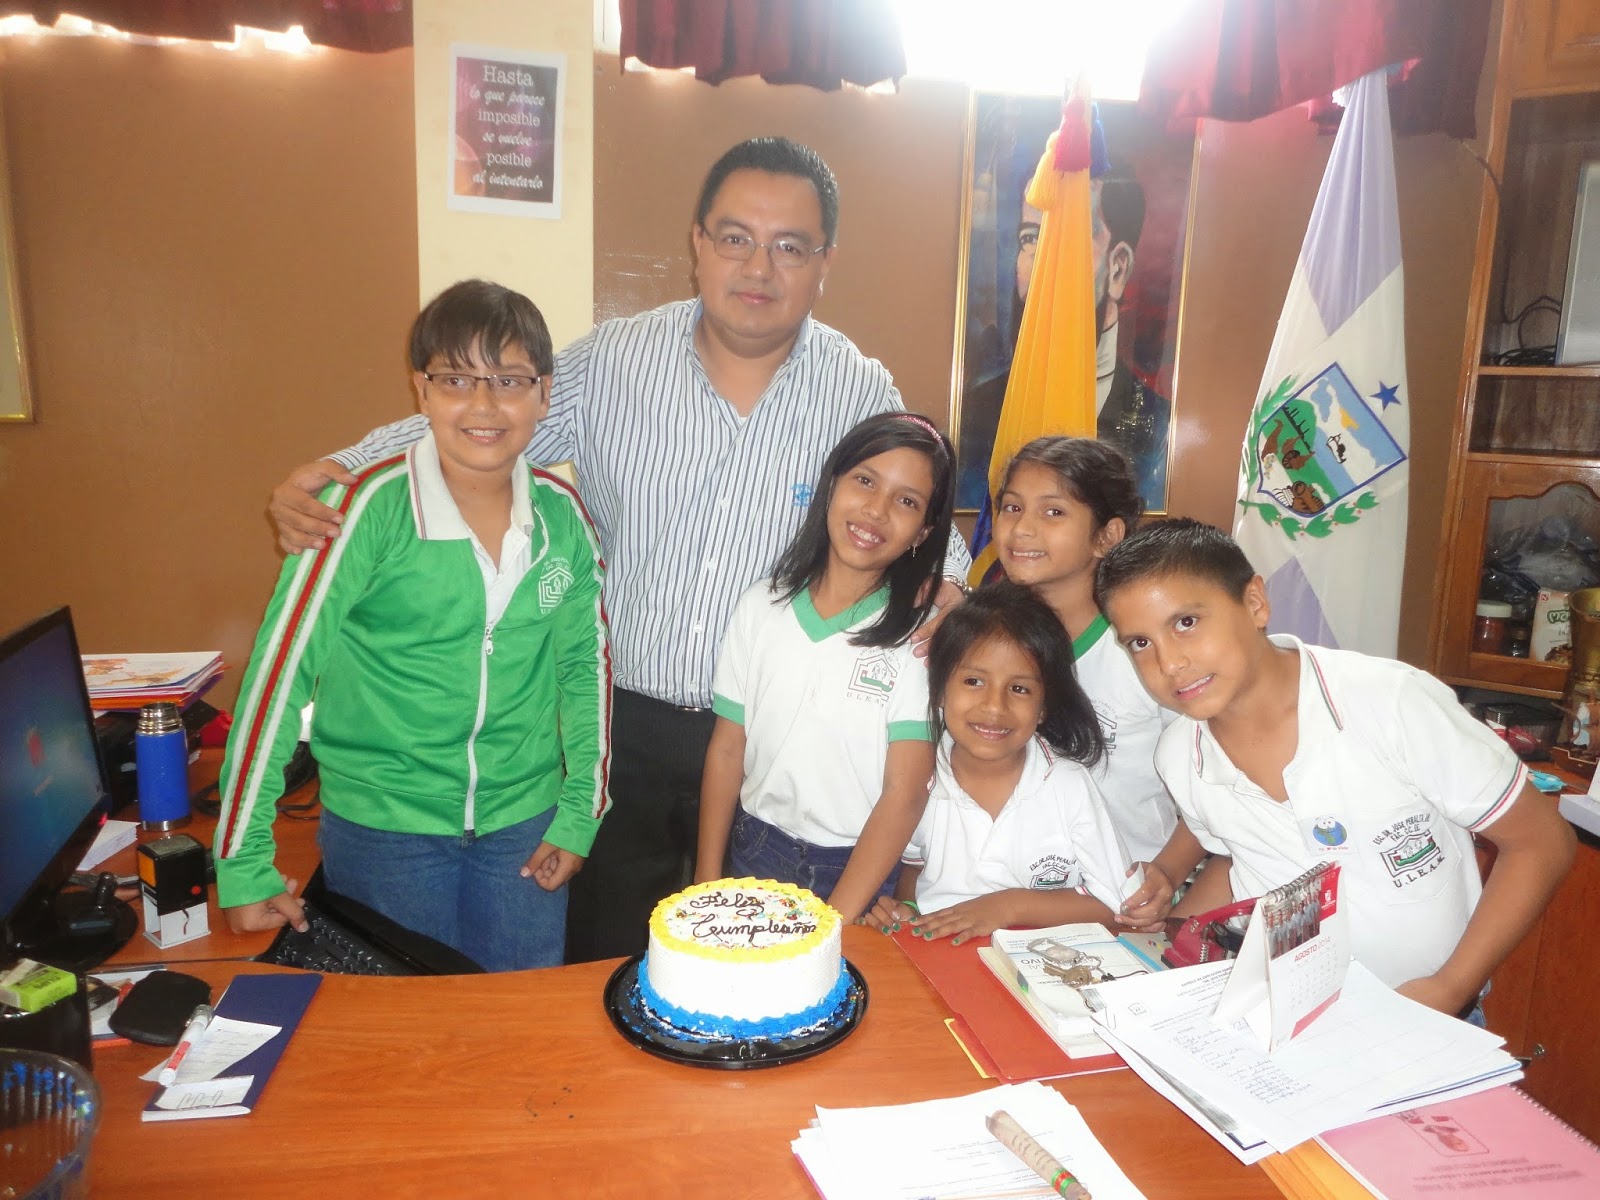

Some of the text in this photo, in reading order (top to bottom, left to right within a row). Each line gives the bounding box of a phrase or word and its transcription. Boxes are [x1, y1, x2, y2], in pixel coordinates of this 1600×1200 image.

[482, 64, 534, 87] Hasta
[469, 84, 546, 106] lo que parece
[477, 108, 541, 127] imposible
[482, 131, 533, 147] se vuelve
[486, 152, 532, 168] posible
[472, 170, 544, 189] al intentarlo
[689, 891, 765, 917] Feliz
[1293, 943, 1318, 963] AGOSTO
